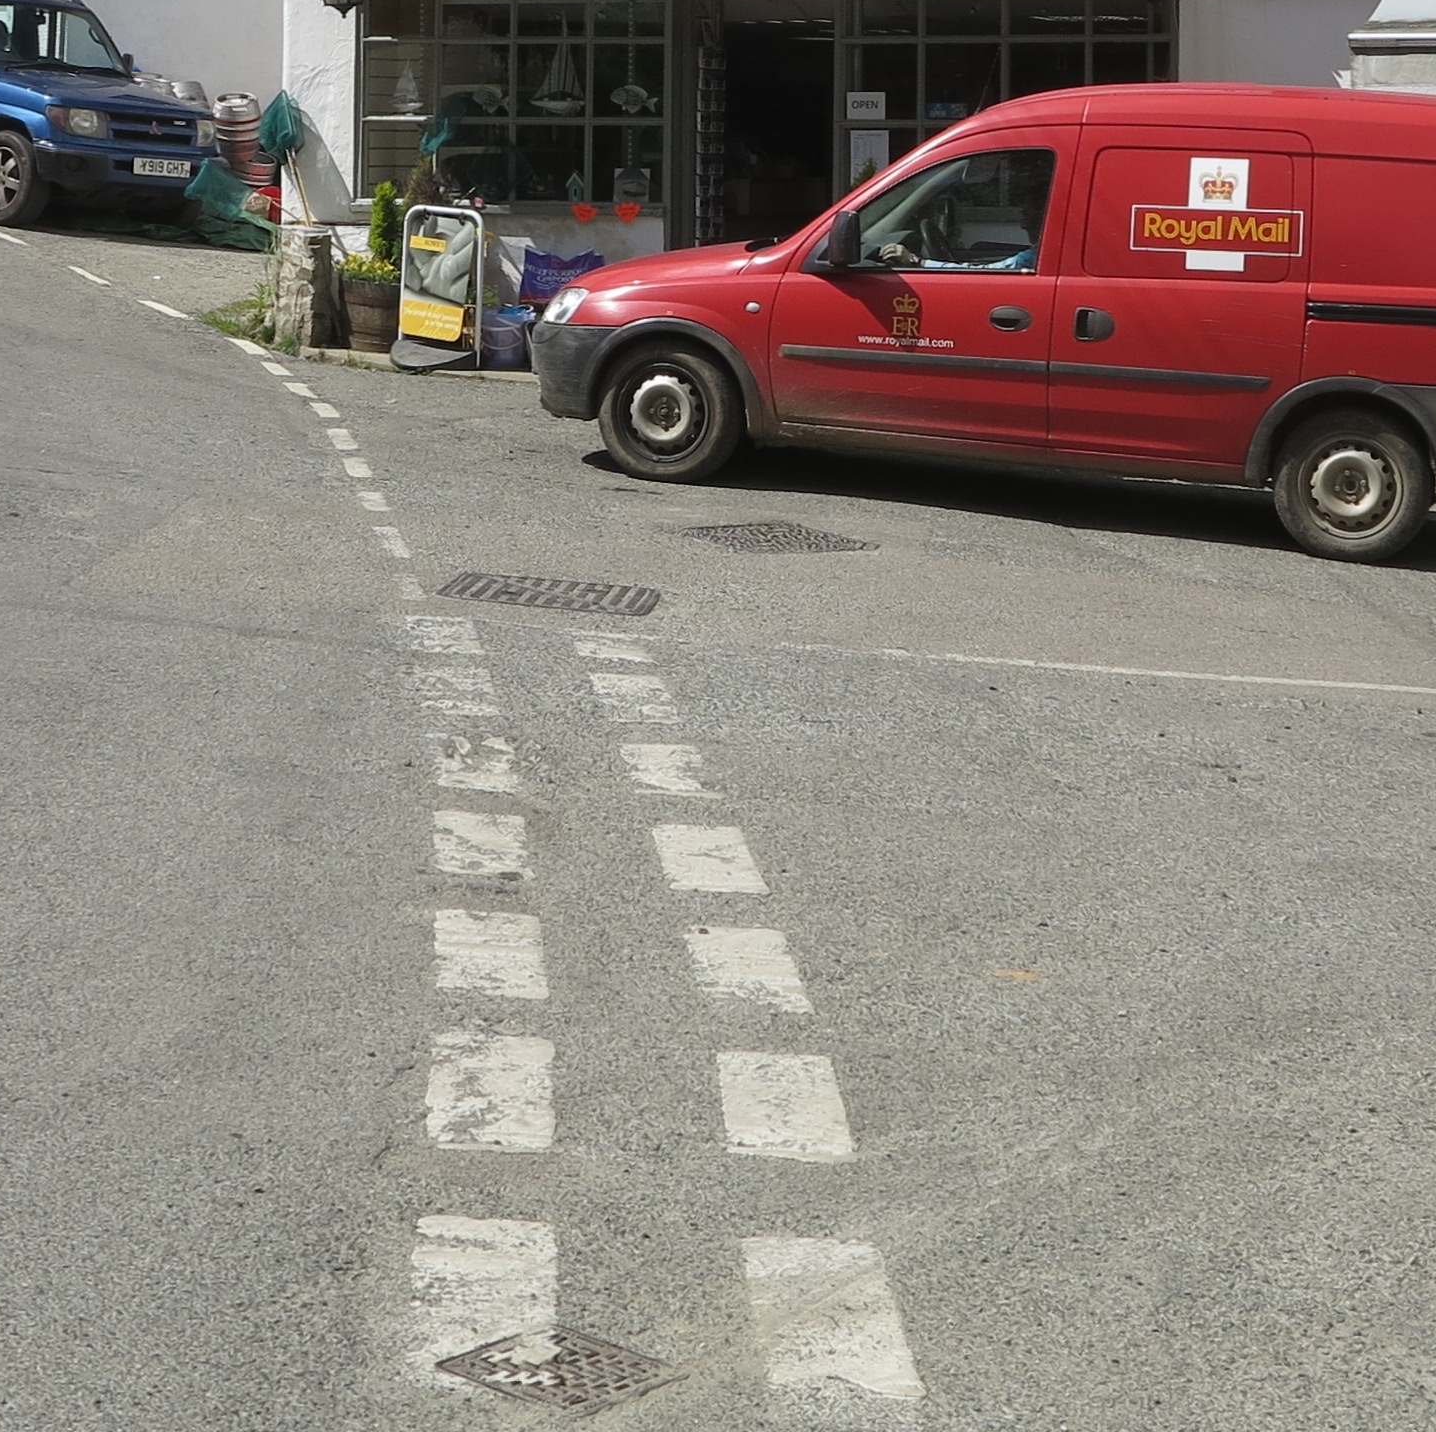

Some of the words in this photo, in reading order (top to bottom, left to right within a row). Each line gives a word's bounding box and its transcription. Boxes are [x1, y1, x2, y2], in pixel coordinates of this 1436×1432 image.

[851, 100, 879, 110] OPEN
[1143, 212, 1223, 245] Royal
[1227, 216, 1290, 243] Mail
[858, 335, 954, 348] www.royalmail.com
